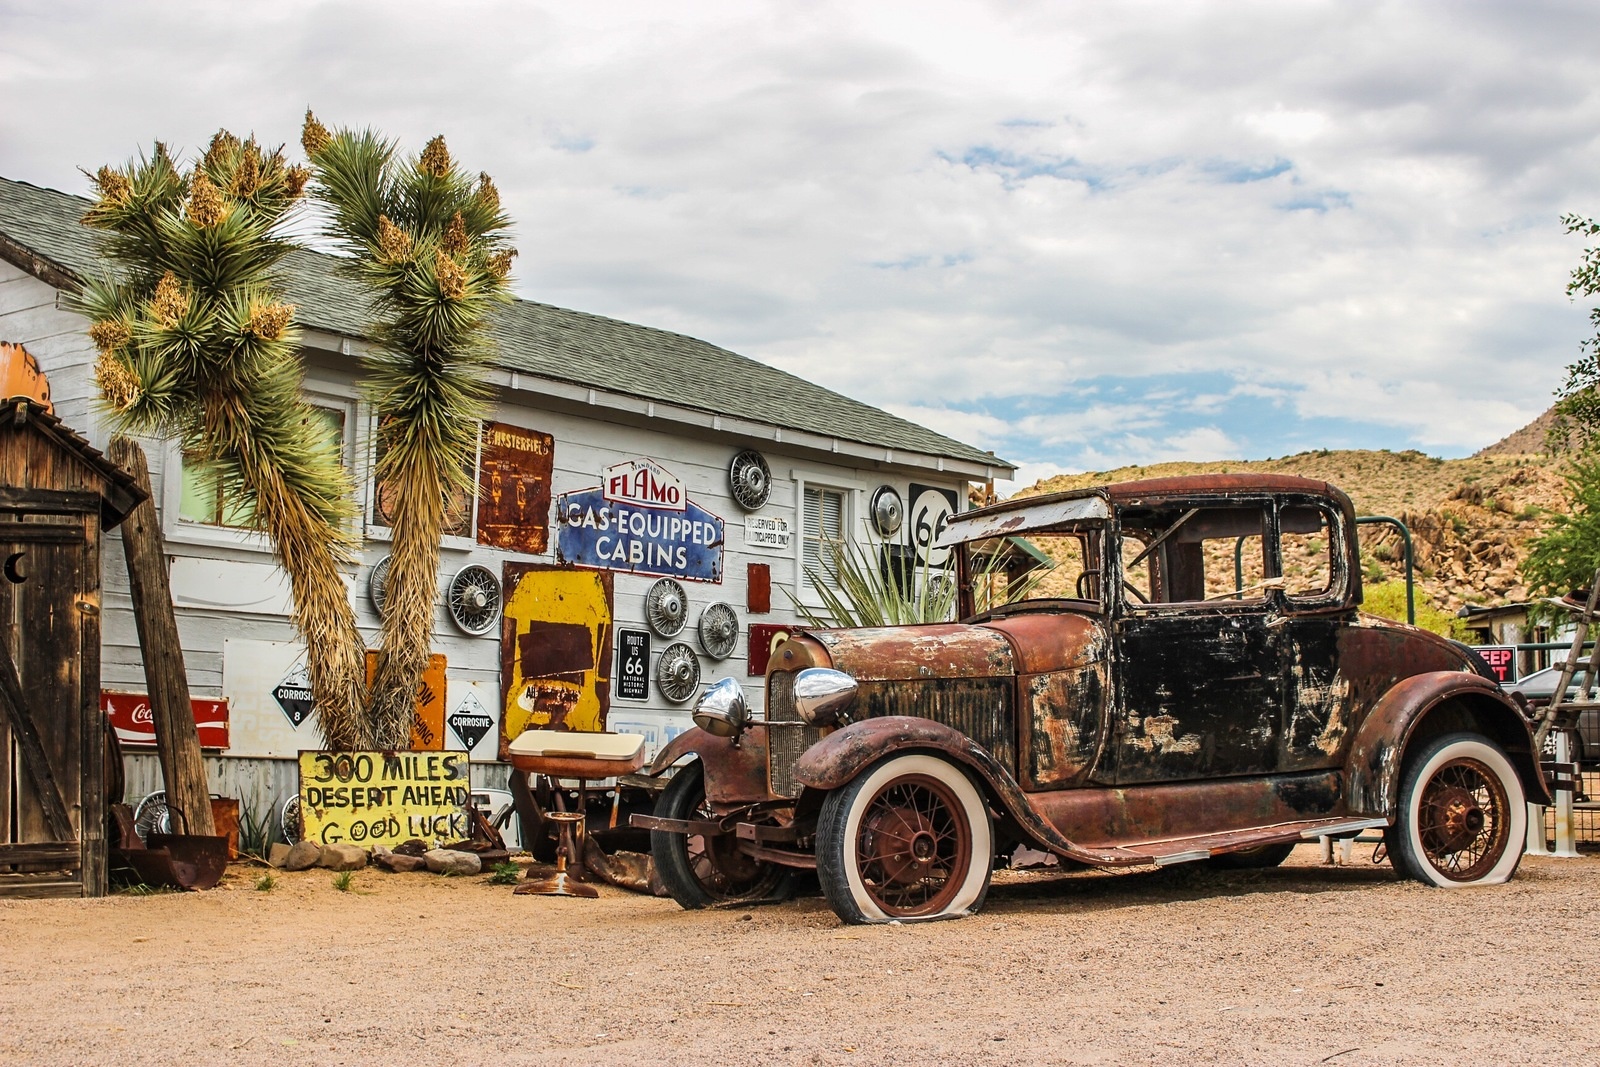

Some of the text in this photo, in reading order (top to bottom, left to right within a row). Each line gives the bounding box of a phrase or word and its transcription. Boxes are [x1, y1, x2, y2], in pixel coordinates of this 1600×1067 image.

[631, 463, 660, 475] STANDARD
[610, 469, 679, 504] FLAMO
[568, 503, 716, 545] GAS-EQUIPPED
[747, 517, 788, 532] SERVED FOR
[778, 534, 789, 545] ONLY
[595, 536, 687, 570] CABINS
[627, 635, 643, 646] ROUTE
[632, 646, 639, 656] US
[1477, 650, 1511, 665] EEP
[625, 657, 643, 675] 66
[623, 675, 645, 683] NATIONAL
[278, 688, 314, 702] CORROSI
[294, 711, 301, 721] 8
[452, 716, 490, 728] CORROSIVE
[413, 713, 434, 746] SHING
[467, 737, 474, 746] 8
[314, 754, 459, 783] 300 MILES
[307, 785, 468, 808] DESERT AHEAD
[321, 813, 464, 845] GOOD LUCK
